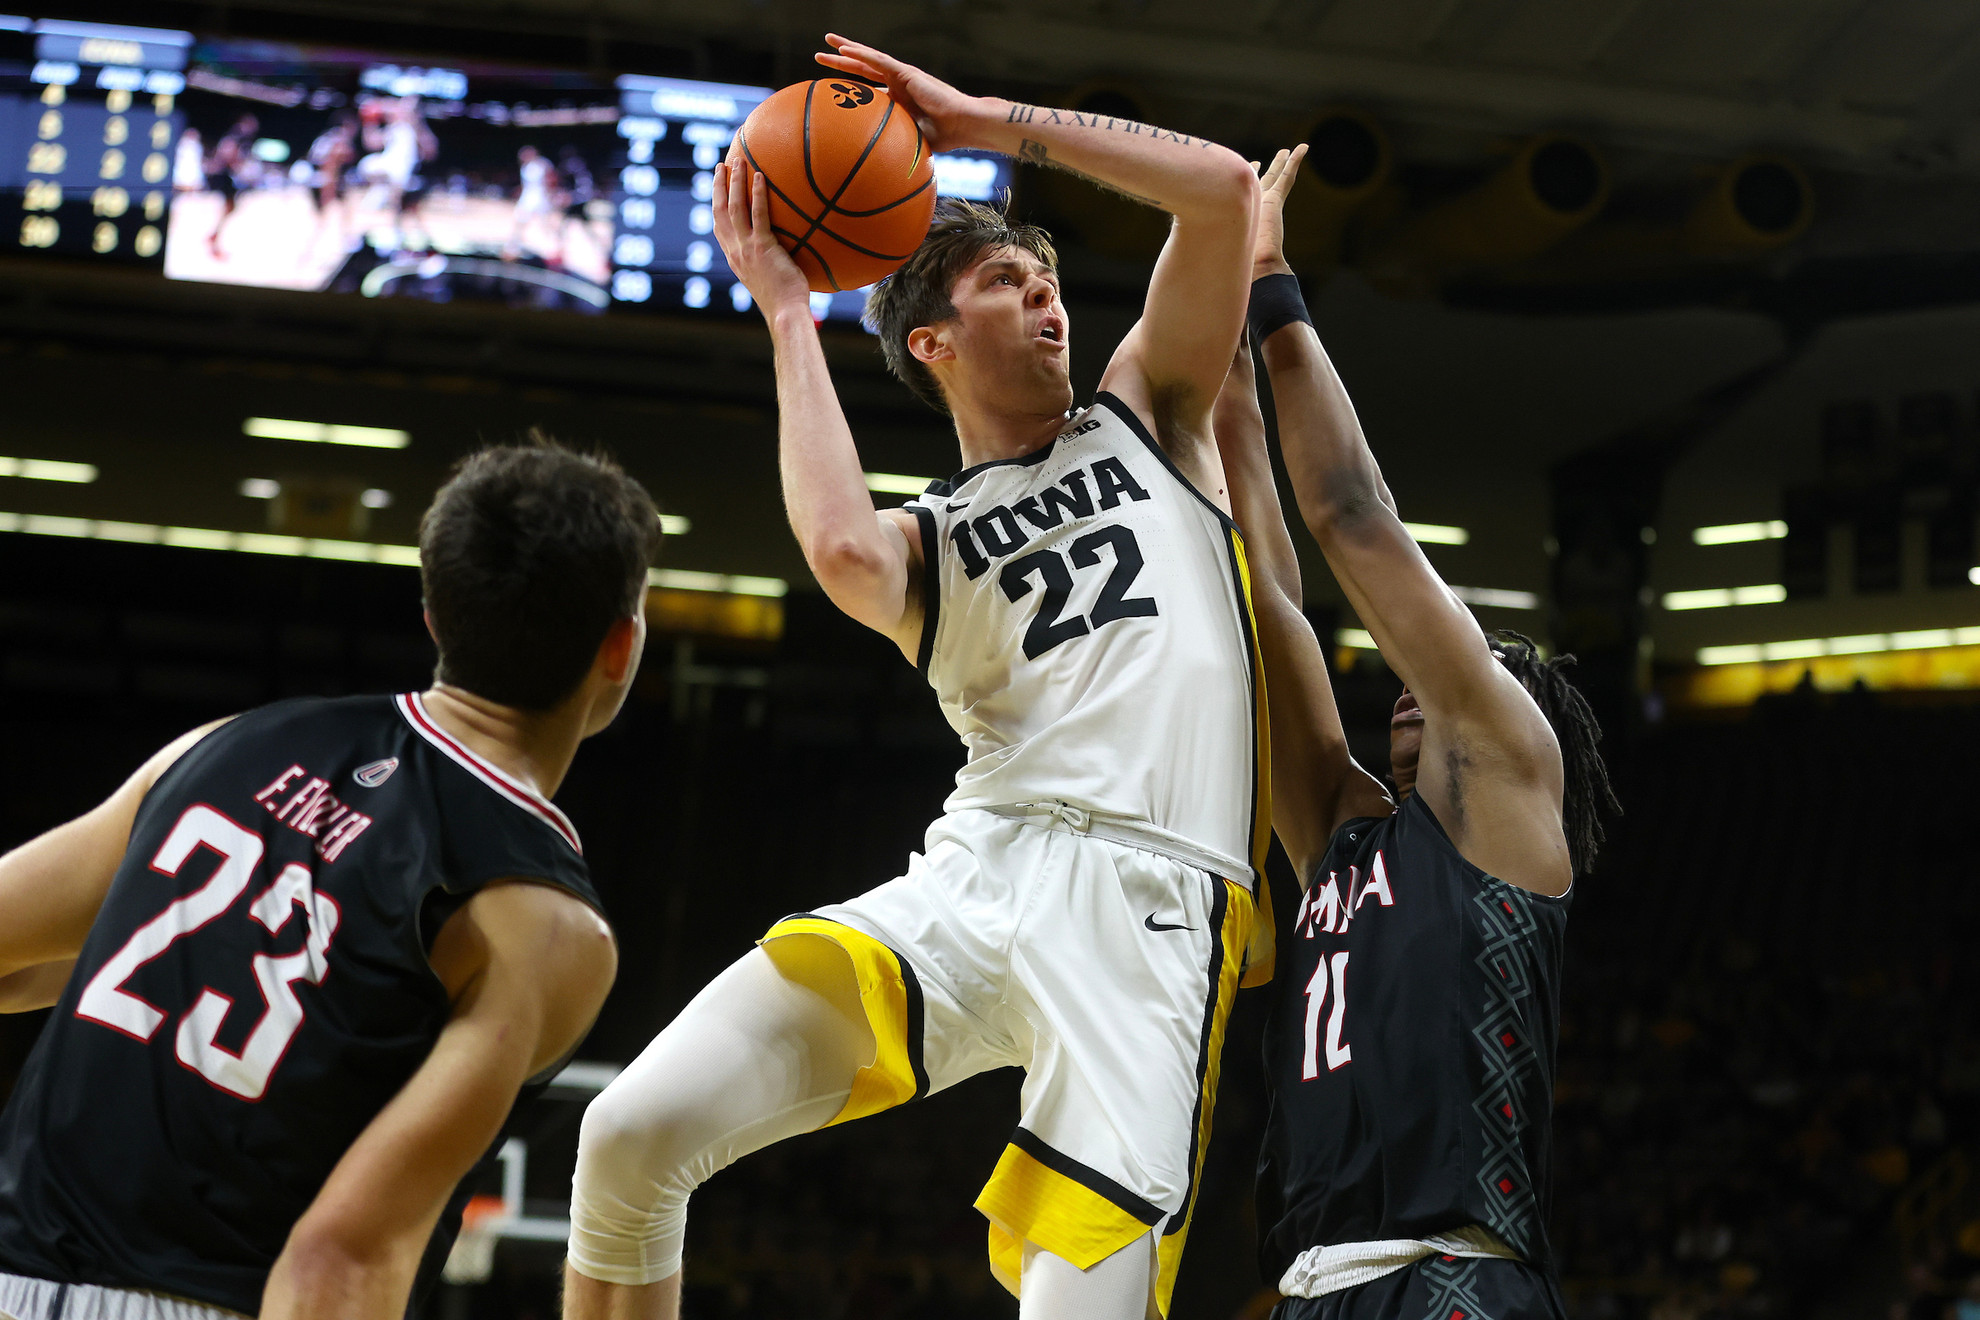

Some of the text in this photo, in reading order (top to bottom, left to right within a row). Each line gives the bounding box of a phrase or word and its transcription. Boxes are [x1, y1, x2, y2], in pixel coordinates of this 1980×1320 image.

[950, 456, 1151, 581] IOWA
[999, 524, 1159, 661] 22
[74, 802, 342, 1102] 23
